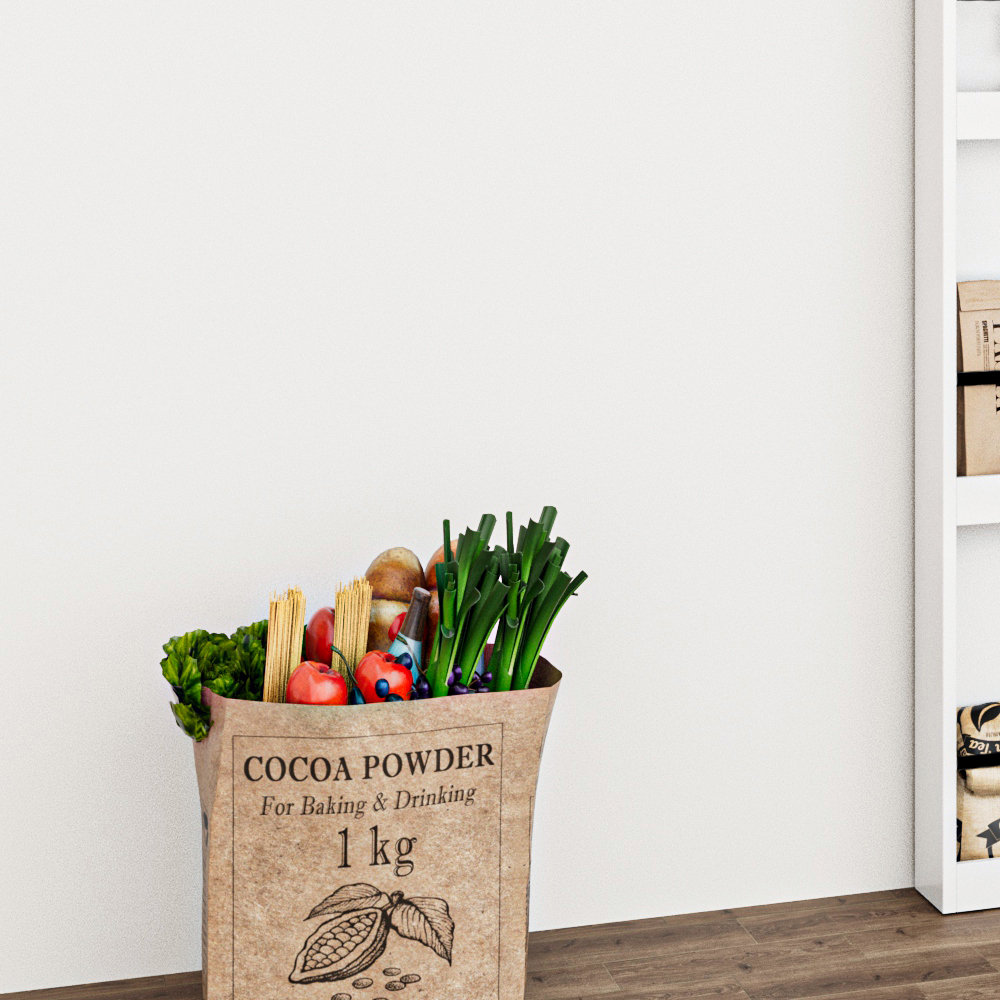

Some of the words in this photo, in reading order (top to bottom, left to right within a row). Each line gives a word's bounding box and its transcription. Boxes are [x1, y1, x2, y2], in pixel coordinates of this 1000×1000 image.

[243, 755, 352, 782] COCOA
[362, 743, 494, 780] POWDER
[968, 739, 992, 754] Tea
[259, 795, 294, 816] For
[300, 795, 367, 819] Baking
[373, 792, 387, 812] &
[394, 784, 477, 810] Drinking
[337, 827, 352, 869] 1
[369, 825, 417, 877] kg
